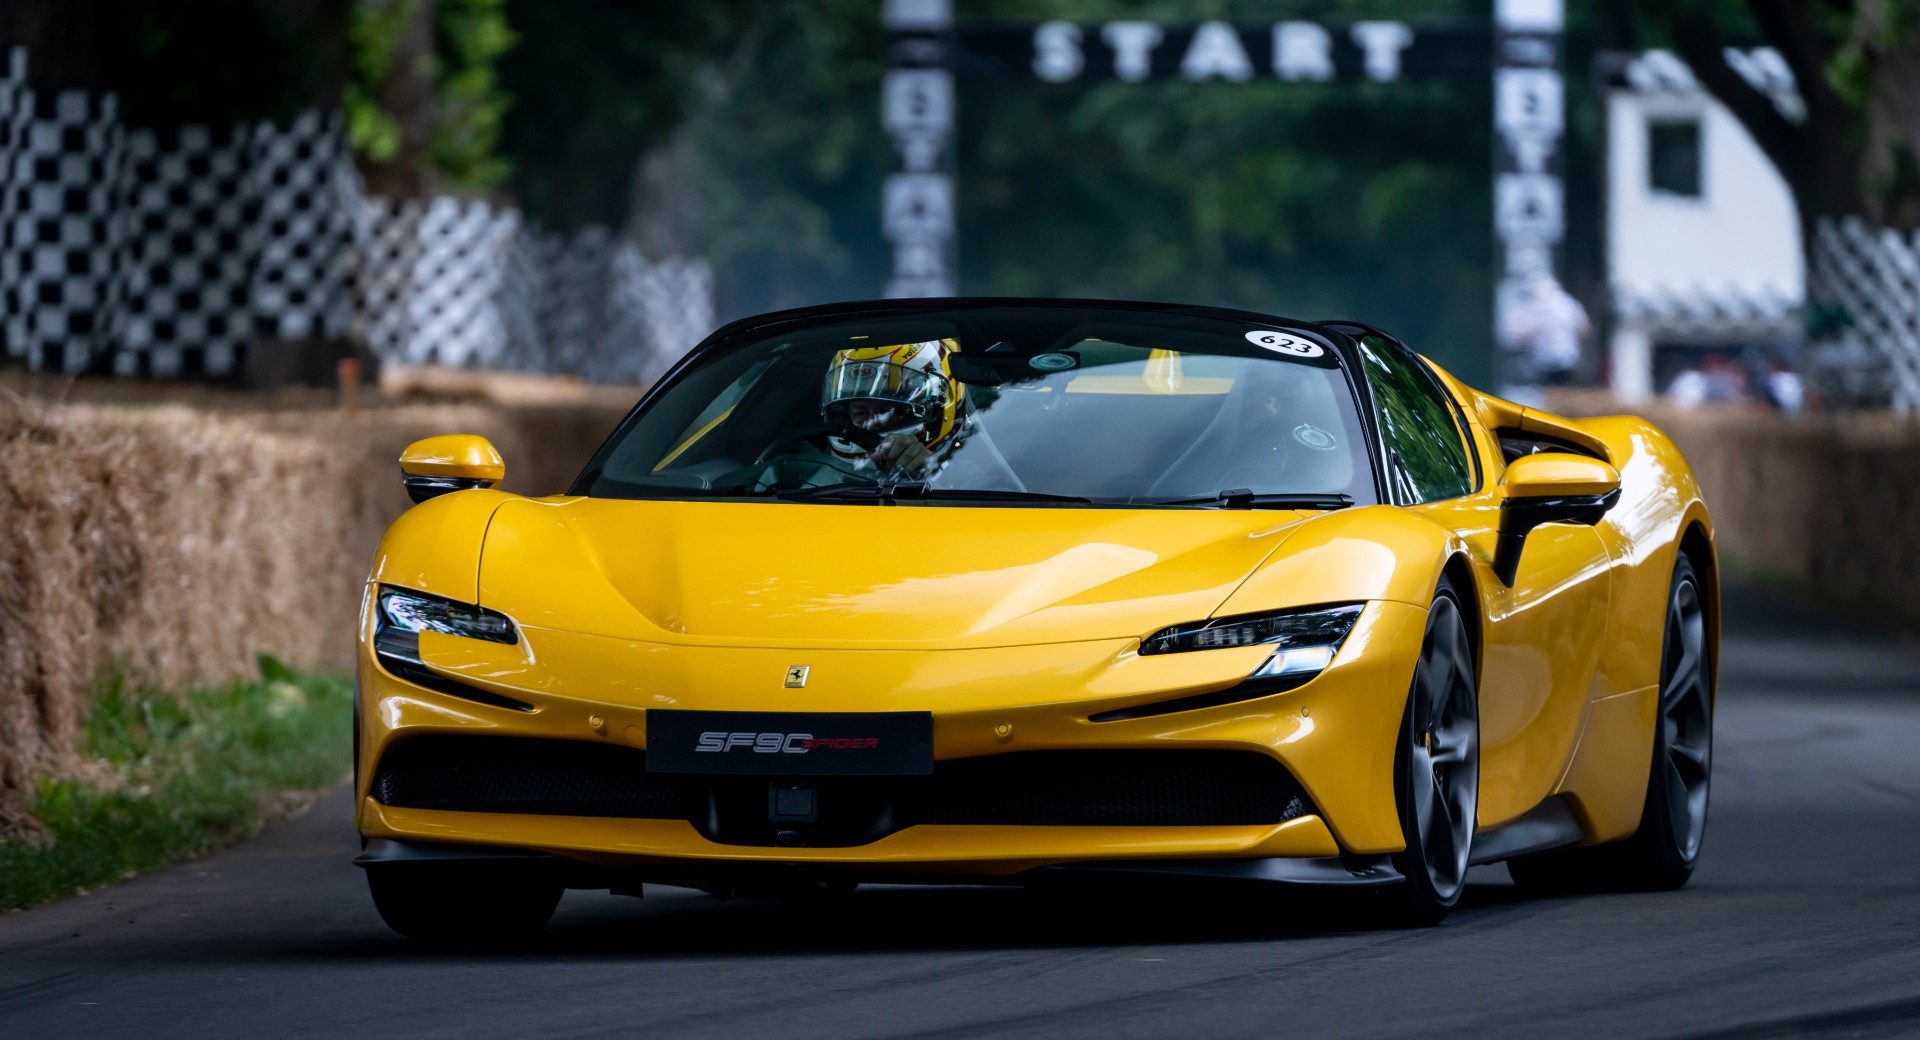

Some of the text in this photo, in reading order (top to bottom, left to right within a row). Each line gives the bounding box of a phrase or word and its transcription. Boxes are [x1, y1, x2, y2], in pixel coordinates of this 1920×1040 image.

[1032, 20, 1413, 82] START
[1260, 336, 1312, 353] 623
[695, 732, 879, 753] SF90 SPIDER
